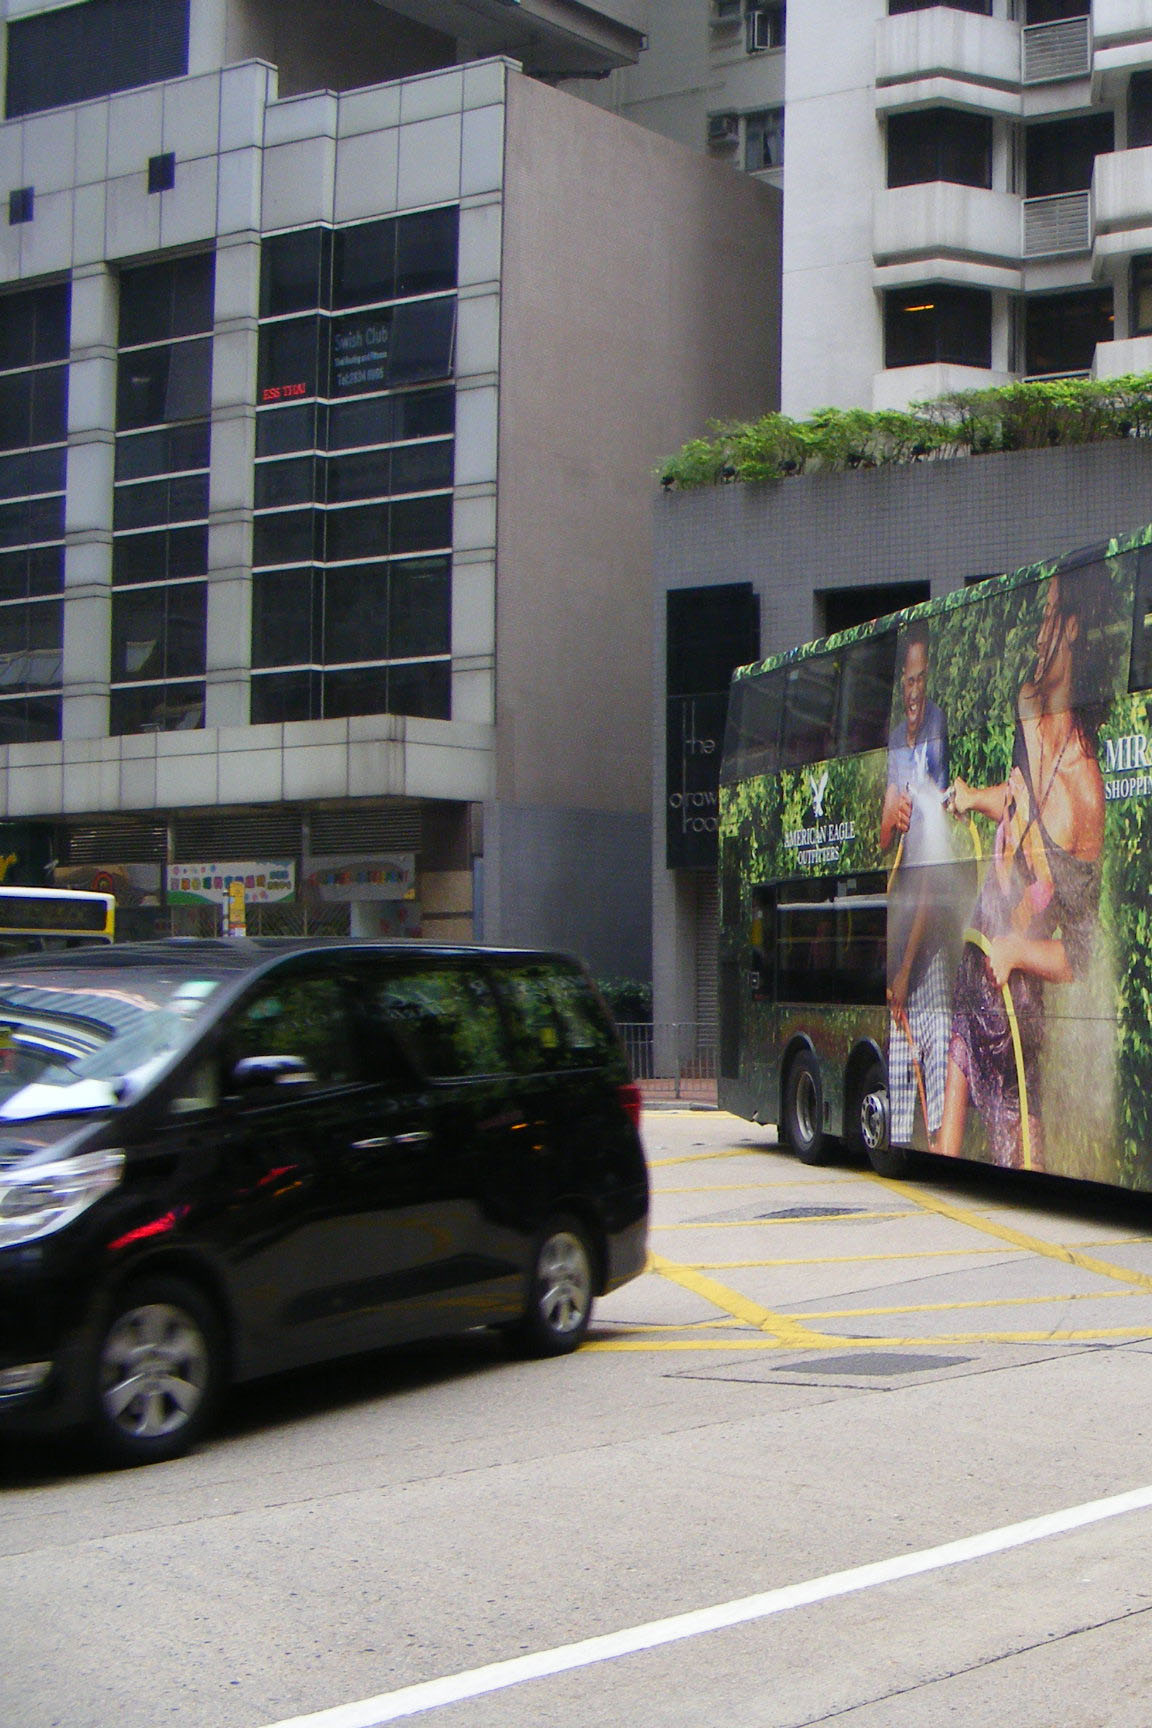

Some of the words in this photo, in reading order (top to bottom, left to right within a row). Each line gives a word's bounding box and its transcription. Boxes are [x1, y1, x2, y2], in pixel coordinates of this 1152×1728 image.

[365, 326, 388, 345] Club
[784, 825, 827, 848] AMERICAN
[828, 821, 856, 842] EAGLE
